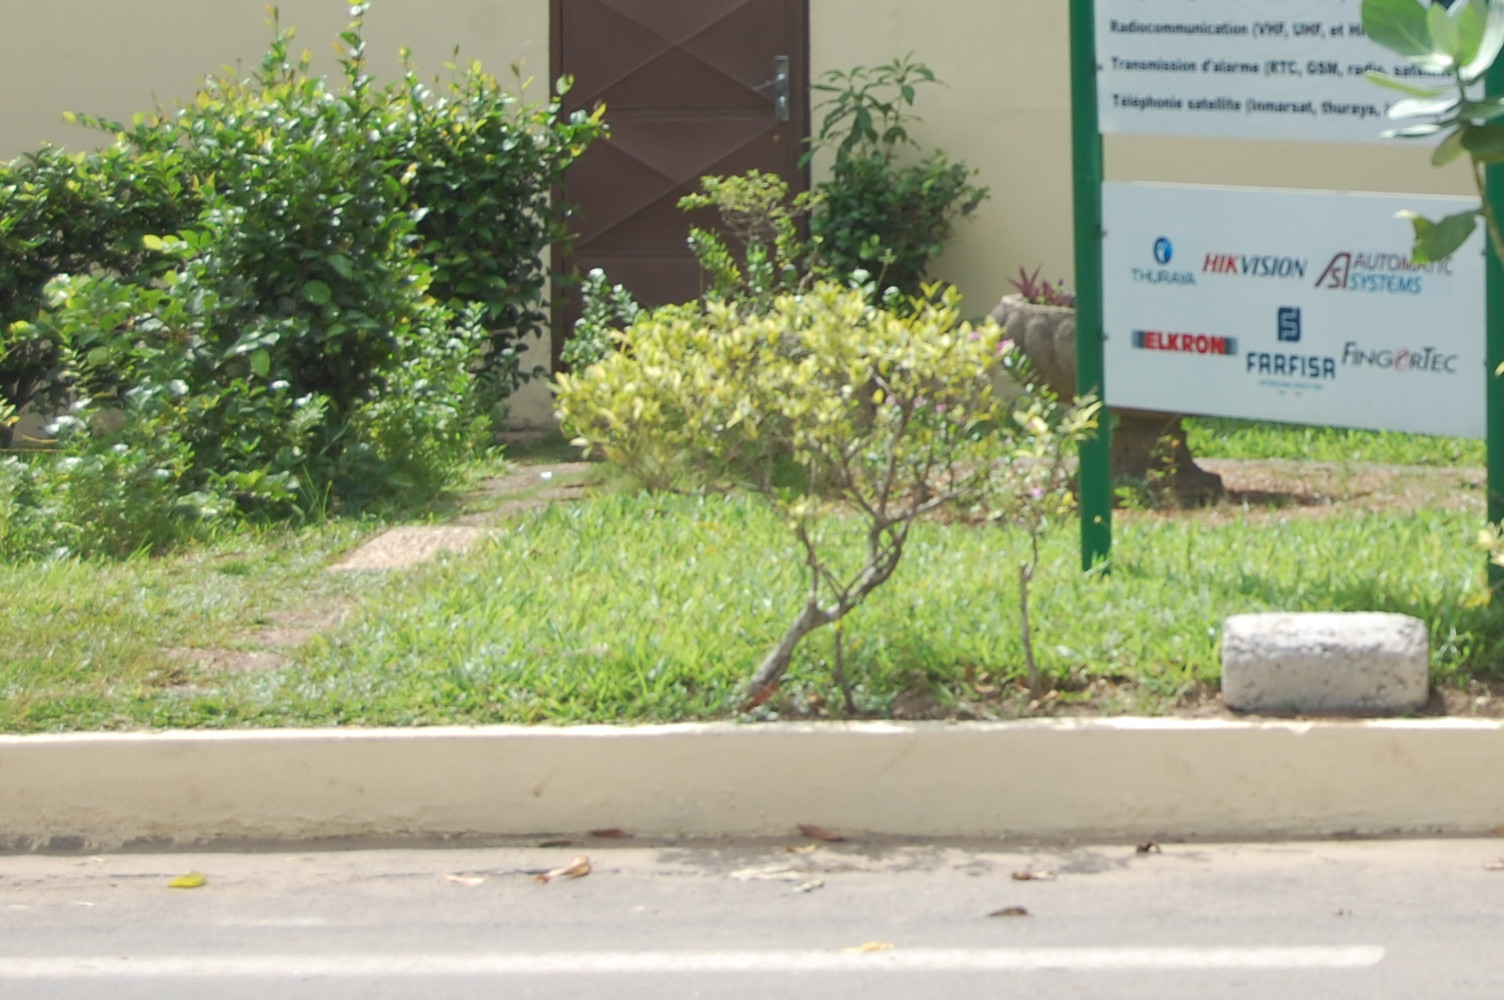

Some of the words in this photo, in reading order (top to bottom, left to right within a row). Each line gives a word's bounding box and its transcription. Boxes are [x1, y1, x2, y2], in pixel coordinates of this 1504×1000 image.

[1110, 20, 1248, 37] Radiocommunication
[1330, 23, 1345, 37] et
[1111, 57, 1197, 73] Transmission
[1202, 57, 1258, 74] d'alarme
[1113, 94, 1182, 113] Téléphonie
[1188, 96, 1241, 112] satellite
[1203, 252, 1308, 279] HIKVISION
[1131, 267, 1196, 286] THURAYA
[1349, 274, 1423, 296] SYSTEMS
[1145, 331, 1225, 355] ELKRON
[1246, 352, 1336, 379] FARFISA
